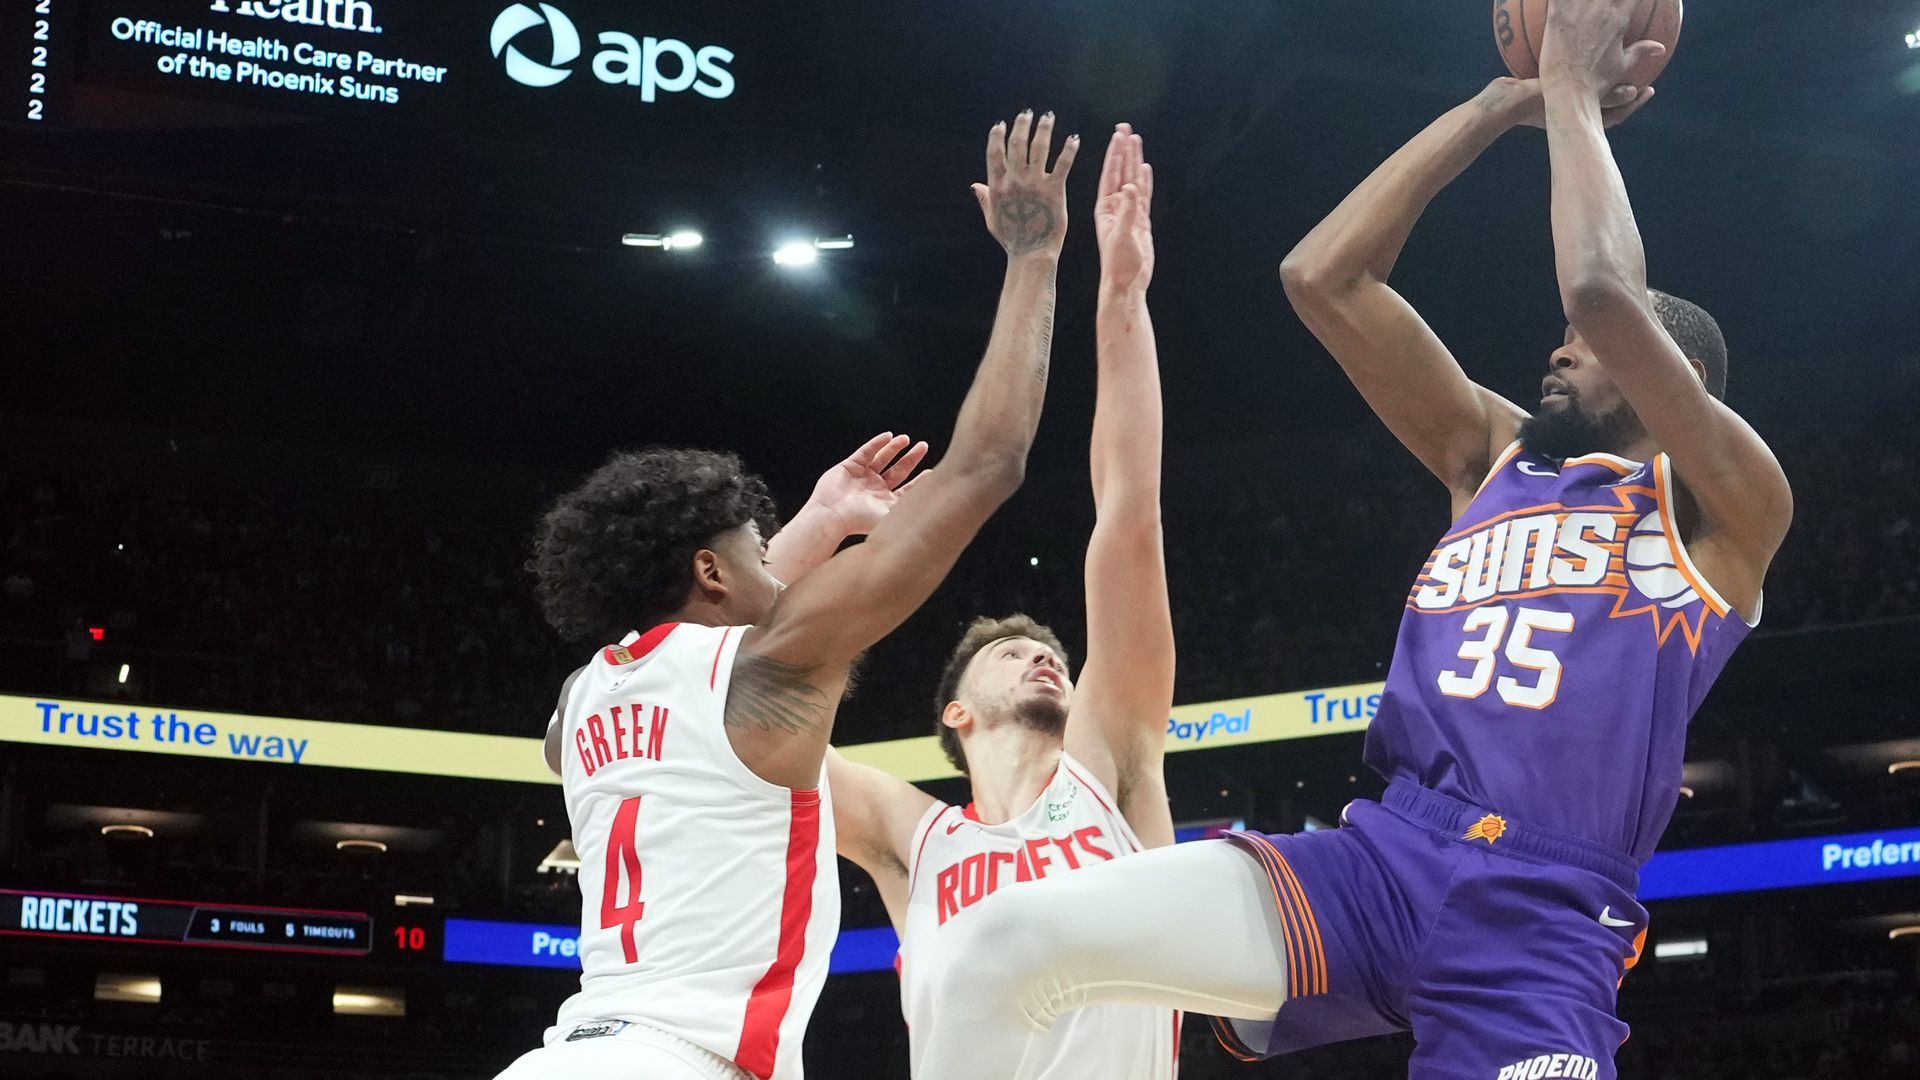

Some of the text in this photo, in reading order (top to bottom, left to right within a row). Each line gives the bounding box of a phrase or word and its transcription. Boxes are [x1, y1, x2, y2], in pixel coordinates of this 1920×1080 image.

[33, 20, 49, 40] 2
[210, 0, 382, 33] ealth.
[32, 47, 47, 67] 2
[111, 17, 447, 83] Official Health Care Partner
[592, 31, 735, 102] aps
[30, 73, 45, 93] 2
[157, 53, 399, 103] of the Phoenix Suns
[27, 99, 43, 120] 2
[1415, 512, 1619, 609] SUNS
[1437, 606, 1575, 710] 35
[36, 703, 308, 763] Trust the way
[576, 703, 669, 777] GREEN
[601, 796, 645, 963] 4
[20, 895, 138, 936] ROCKETS
[210, 918, 221, 933] 3
[230, 920, 265, 934] FOULS
[303, 925, 356, 940] TIMEOUTS
[395, 926, 425, 951] 10
